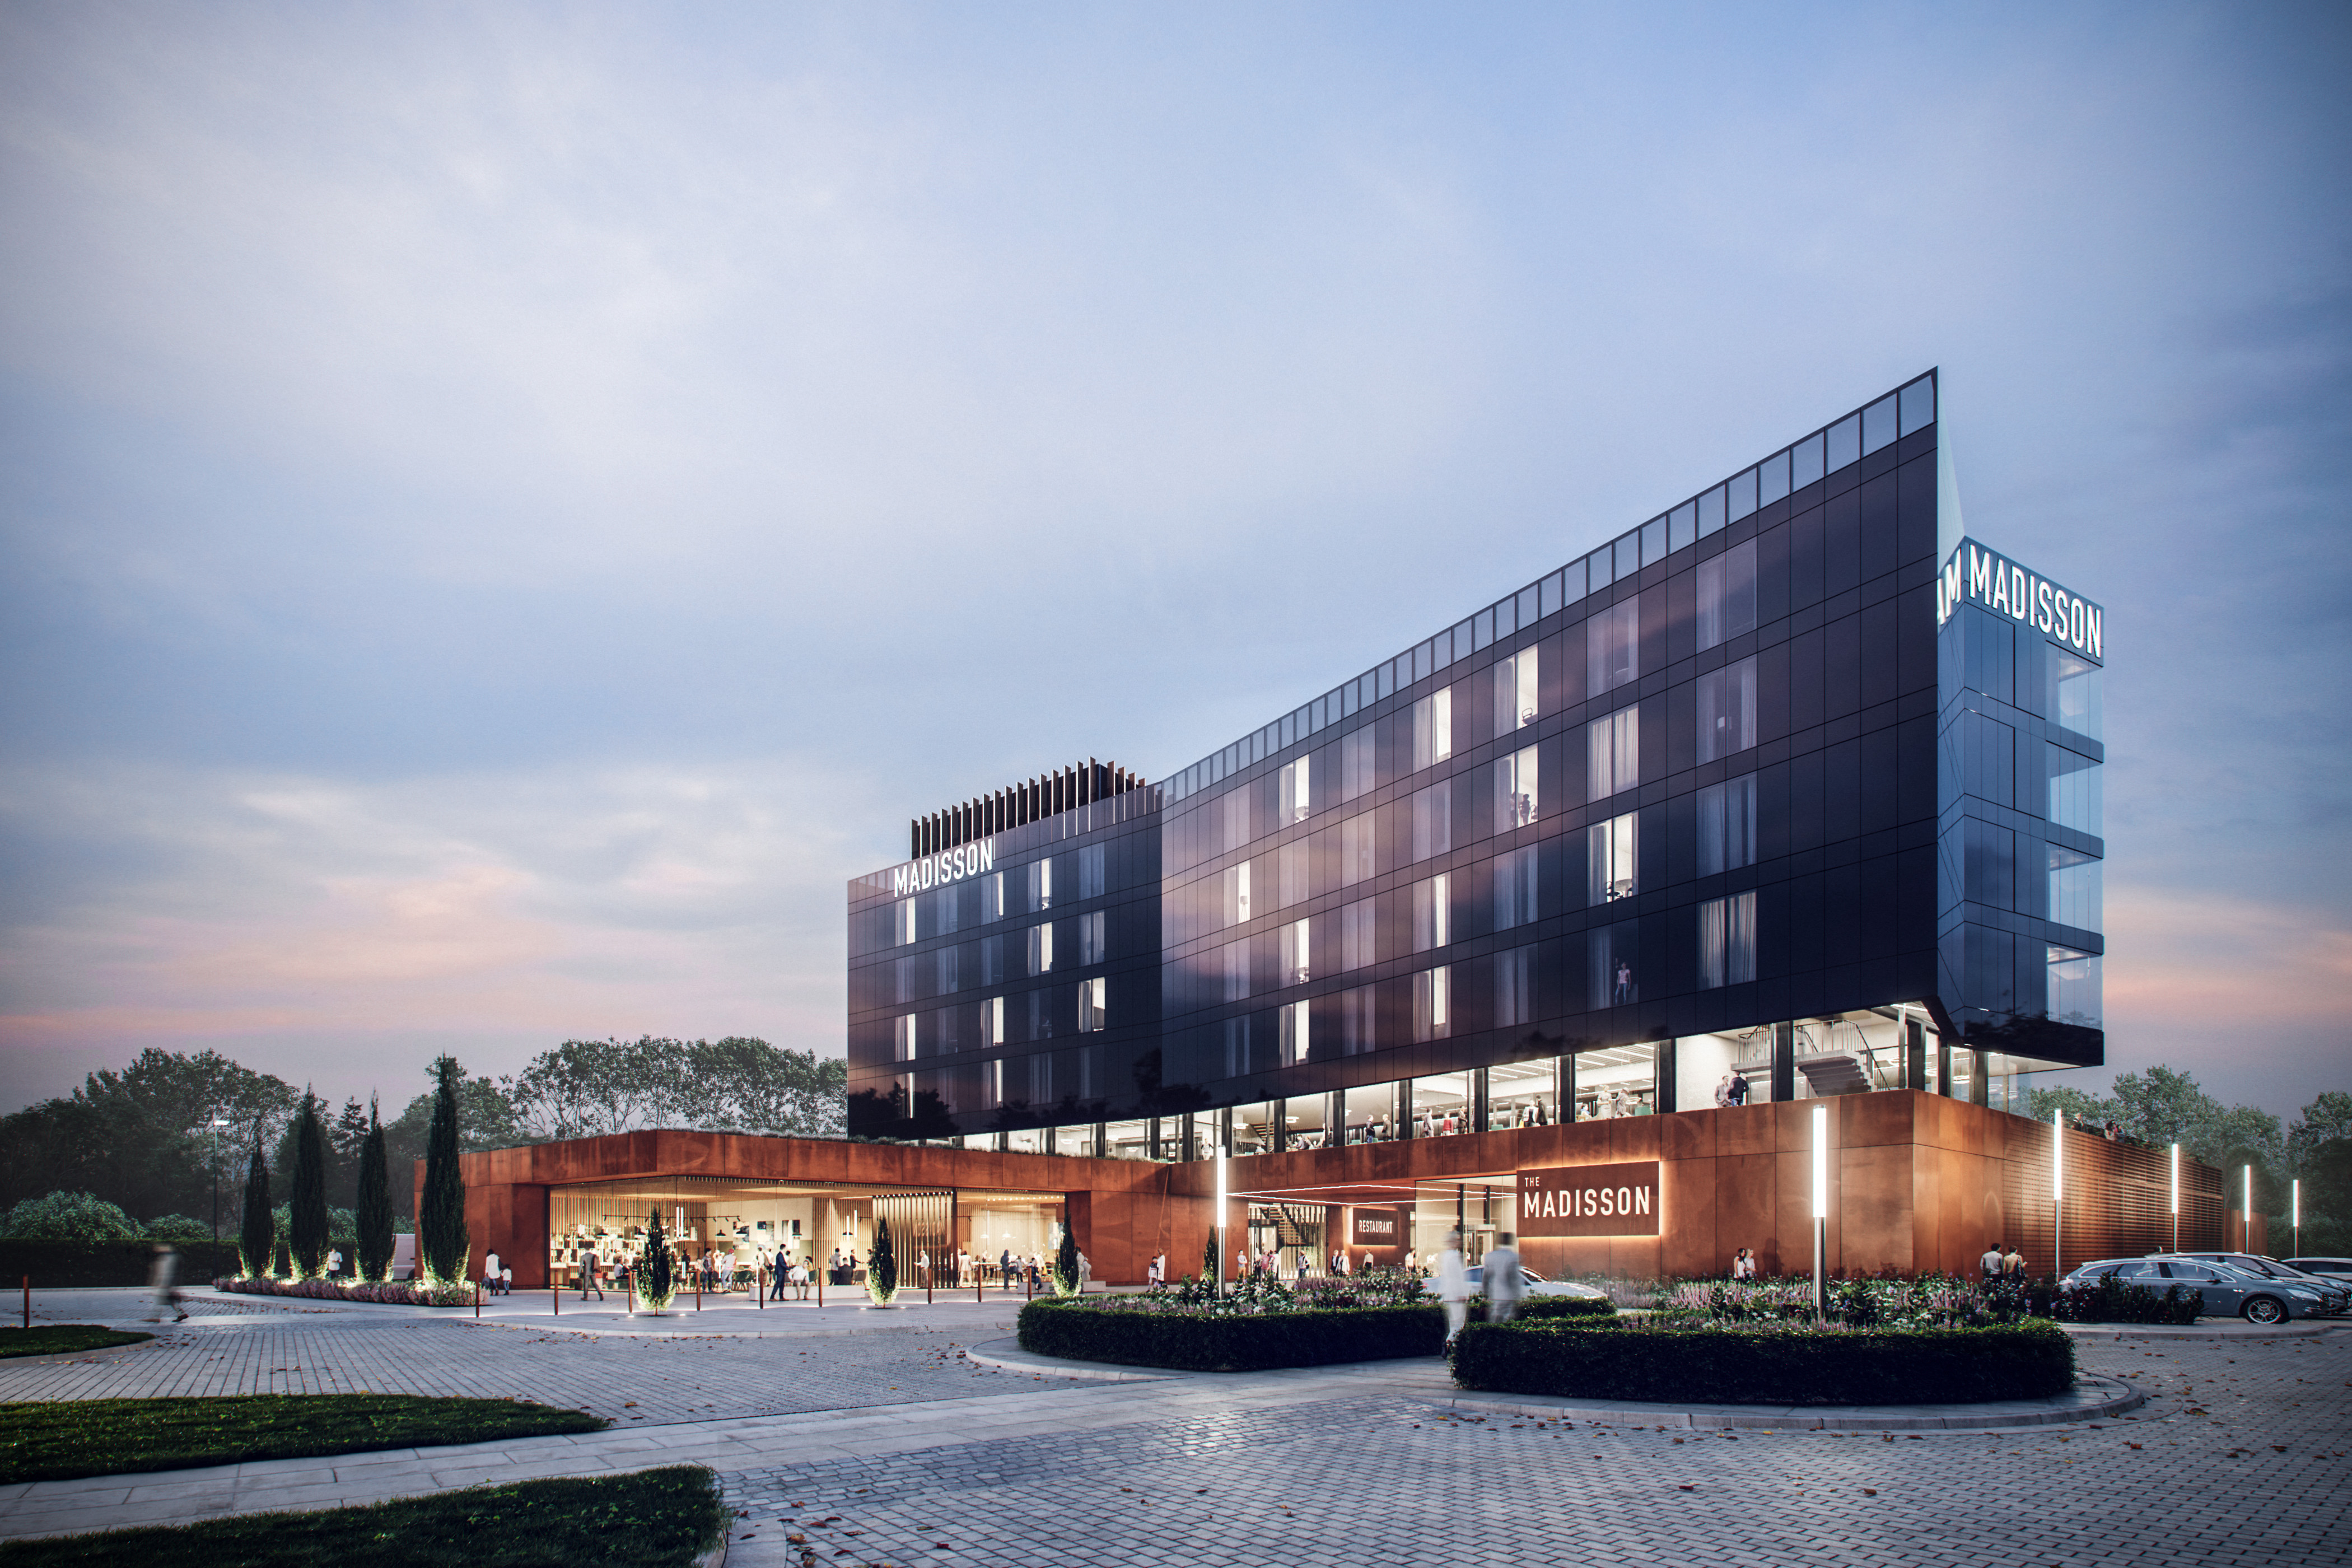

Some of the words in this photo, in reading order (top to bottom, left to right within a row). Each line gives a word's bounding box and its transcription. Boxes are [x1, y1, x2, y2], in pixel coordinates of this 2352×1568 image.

[1969, 544, 2101, 659] MADISSON
[894, 838, 992, 898] MADISSON
[1524, 1177, 1540, 1187] THE
[1524, 1186, 1650, 1218] MADISSON
[1359, 1220, 1393, 1234] RESTAURANT
